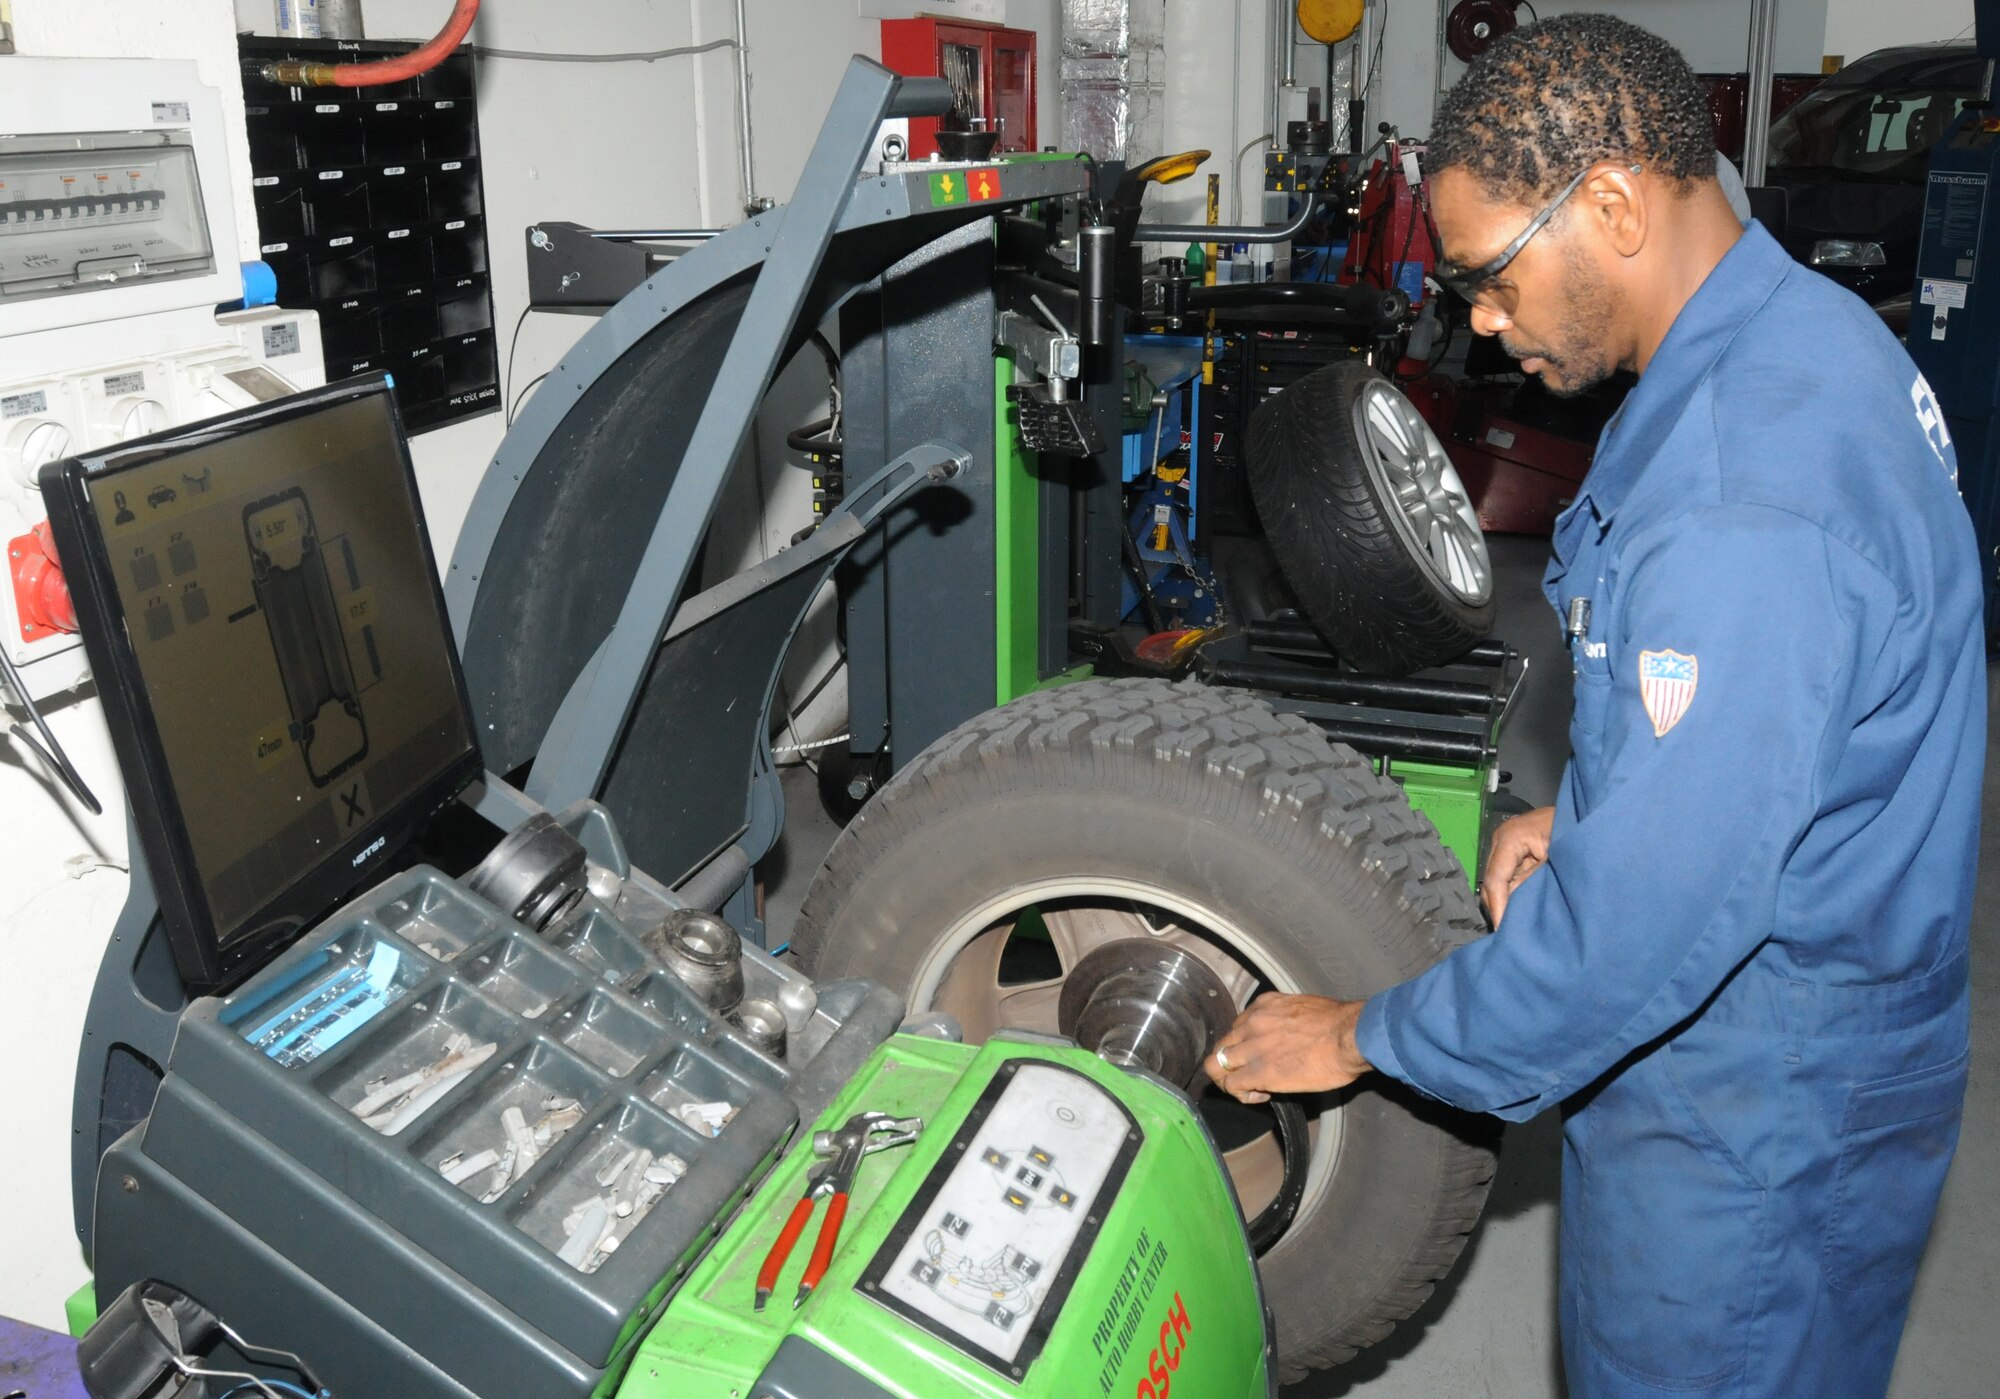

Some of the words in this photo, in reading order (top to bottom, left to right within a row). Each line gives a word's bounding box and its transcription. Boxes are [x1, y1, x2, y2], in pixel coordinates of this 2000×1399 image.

[1023, 1170, 1037, 1186] OK
[948, 1216, 963, 1233] F2
[920, 1266, 934, 1281] F1
[1092, 1251, 1140, 1357] PROPERTY
[1136, 1226, 1151, 1259] OF
[992, 1306, 1008, 1325] F3
[1099, 1346, 1123, 1399] AUTO
[1117, 1292, 1146, 1355] HOBBY
[1140, 1240, 1168, 1301] CENTER
